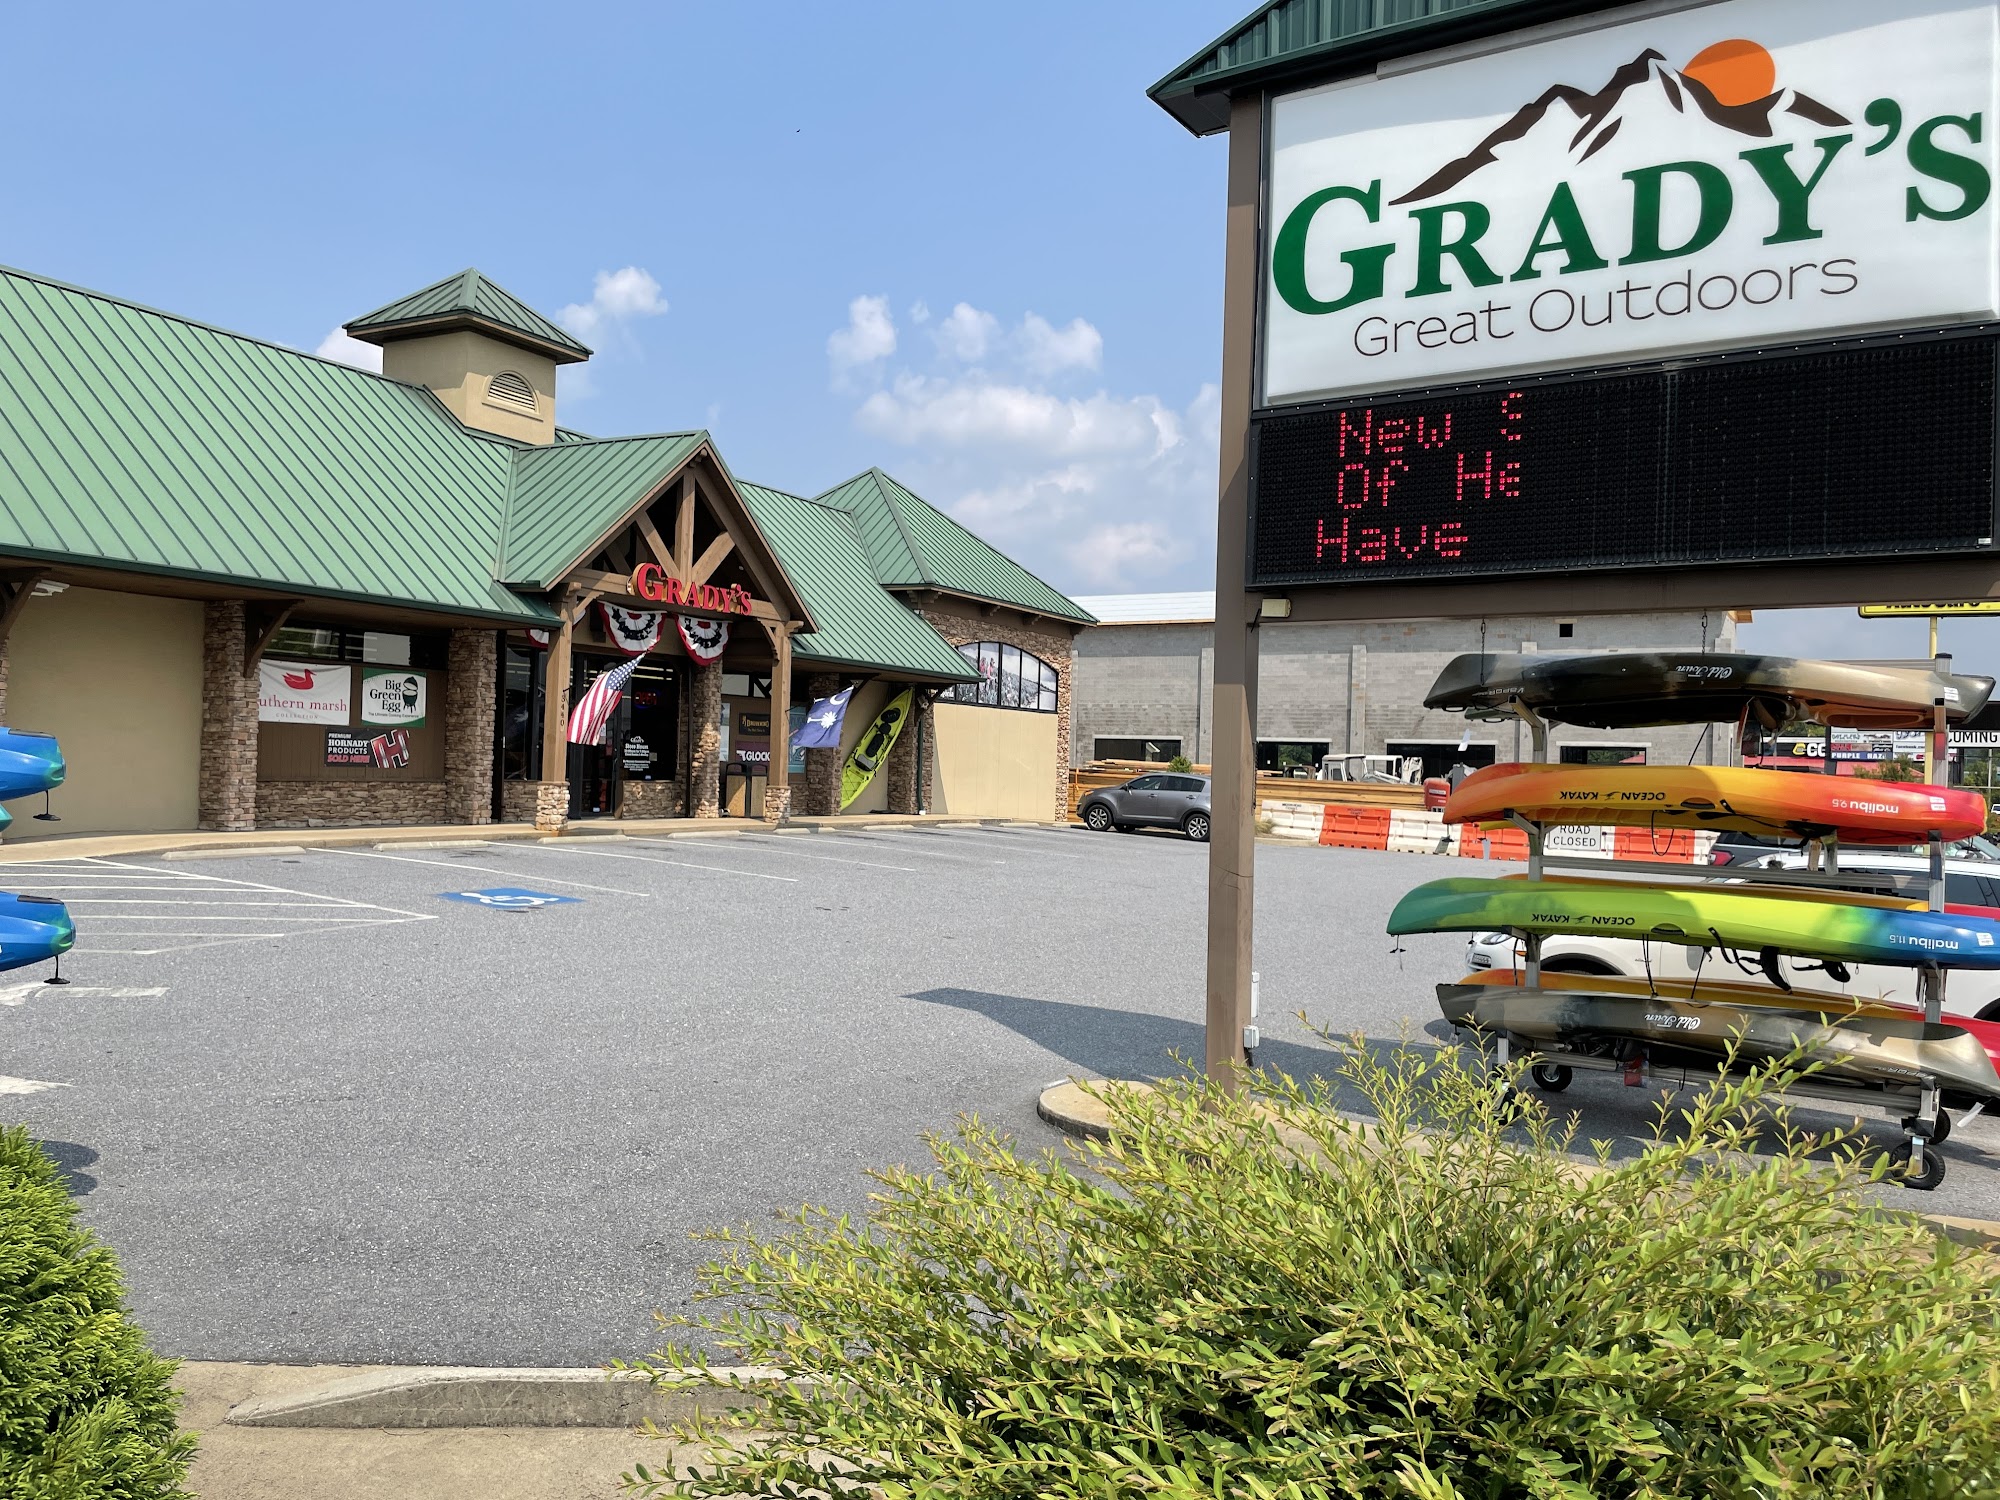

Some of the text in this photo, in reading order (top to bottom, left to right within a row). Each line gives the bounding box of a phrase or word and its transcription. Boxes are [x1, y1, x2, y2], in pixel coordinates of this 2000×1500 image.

[1273, 98, 1991, 314] GRADY'S
[1353, 258, 1859, 357] Great Outdoors
[1338, 409, 1451, 458] New
[1337, 459, 1409, 510] Of
[1316, 517, 1469, 563] Have
[637, 563, 752, 616] GRADY'S
[1675, 665, 1732, 679] Old Town
[385, 680, 402, 692] Big
[370, 689, 401, 700] Green
[258, 695, 347, 712] uthern marsh
[381, 700, 401, 712] Egg
[327, 739, 370, 748] HORNADY
[327, 747, 368, 755] PRODUCTS
[327, 755, 349, 763] SOLD
[1559, 791, 1666, 801] OCEAN KAYAK
[1849, 800, 1899, 814] malibu
[1560, 825, 1591, 835] ROAD
[1553, 837, 1597, 847] CLOSED
[1531, 913, 1636, 926] OCEAN KAYAK
[1908, 936, 1959, 950] malibu
[1644, 1014, 1701, 1030] Old Town
